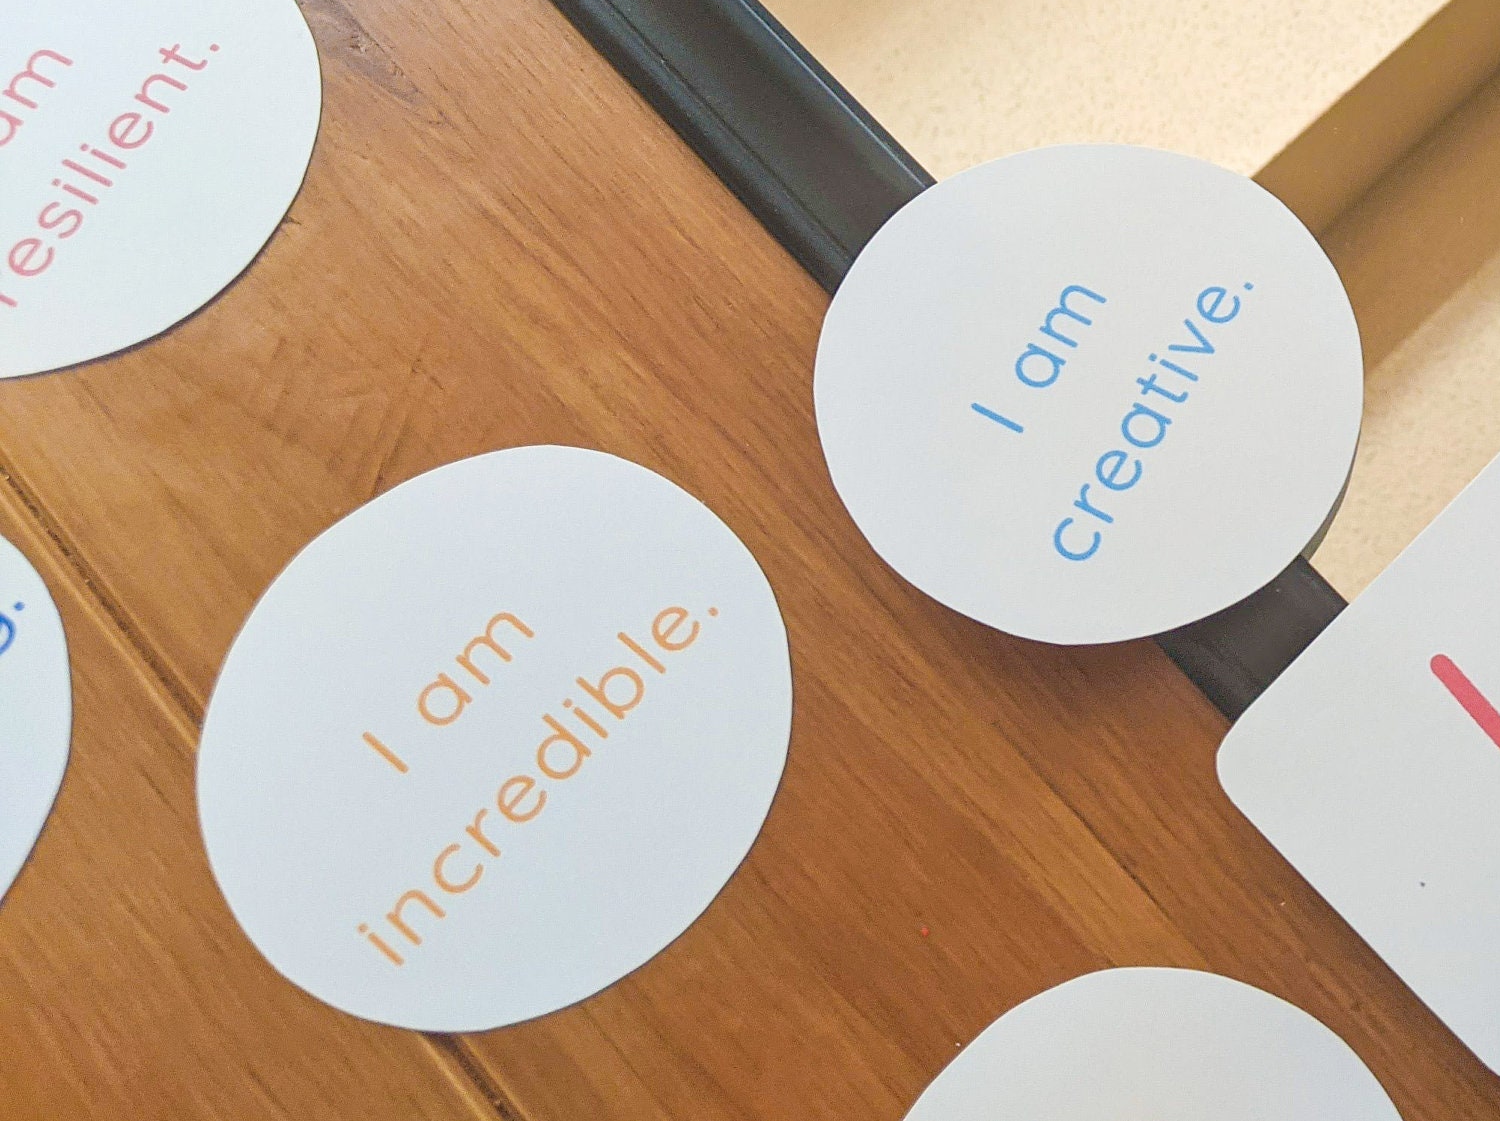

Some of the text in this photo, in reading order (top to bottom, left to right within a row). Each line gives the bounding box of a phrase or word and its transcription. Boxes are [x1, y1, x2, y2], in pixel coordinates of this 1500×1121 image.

[970, 282, 1109, 436] I am
[1051, 280, 1256, 563] creative.
[355, 603, 722, 968] incredible.
[360, 610, 537, 776] I am
